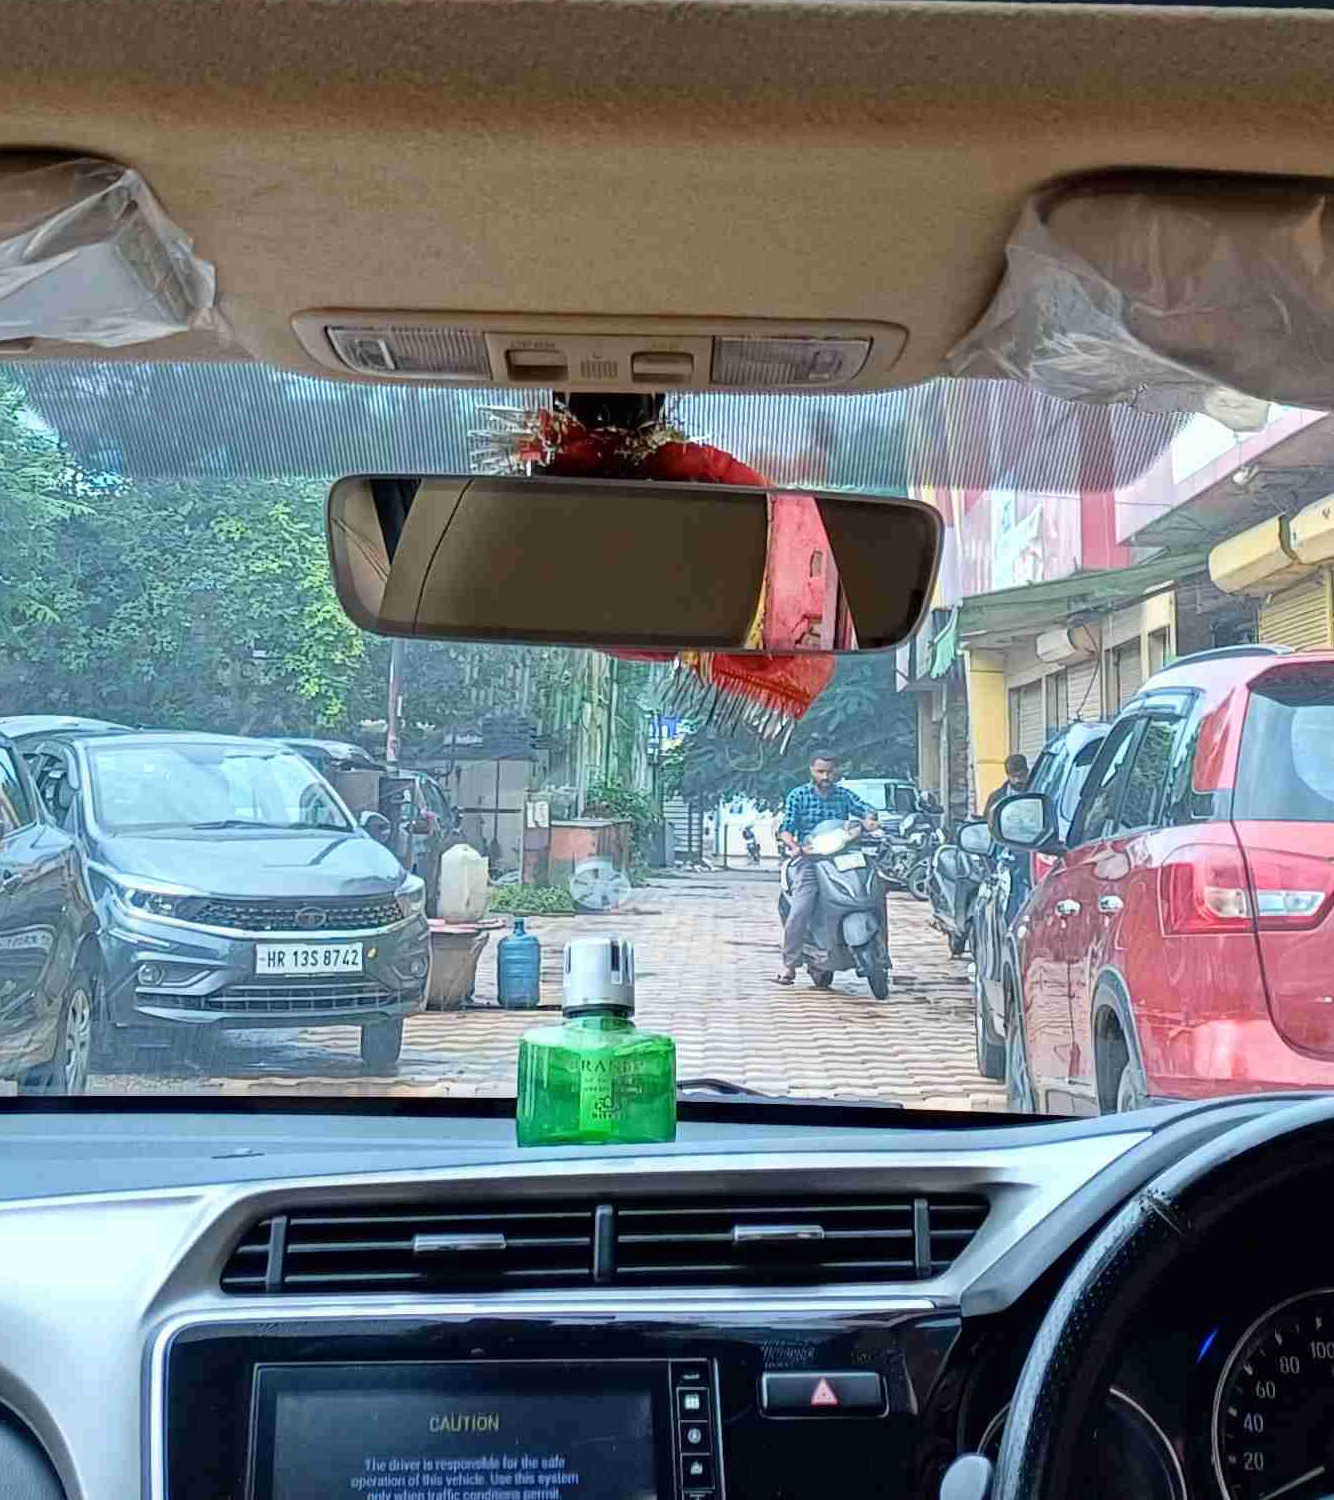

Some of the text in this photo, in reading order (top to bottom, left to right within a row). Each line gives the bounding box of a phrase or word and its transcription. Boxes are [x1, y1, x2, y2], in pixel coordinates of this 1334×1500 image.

[267, 951, 286, 968] HR
[323, 949, 359, 967] 8742
[1279, 1356, 1300, 1375] 80
[1255, 1381, 1276, 1400] 60
[429, 1414, 500, 1433] CAUTION
[1243, 1413, 1264, 1434] 40
[365, 1457, 387, 1472] The
[389, 1457, 420, 1472] driver
[1243, 1452, 1264, 1471] 20
[350, 1474, 406, 1491] operation
